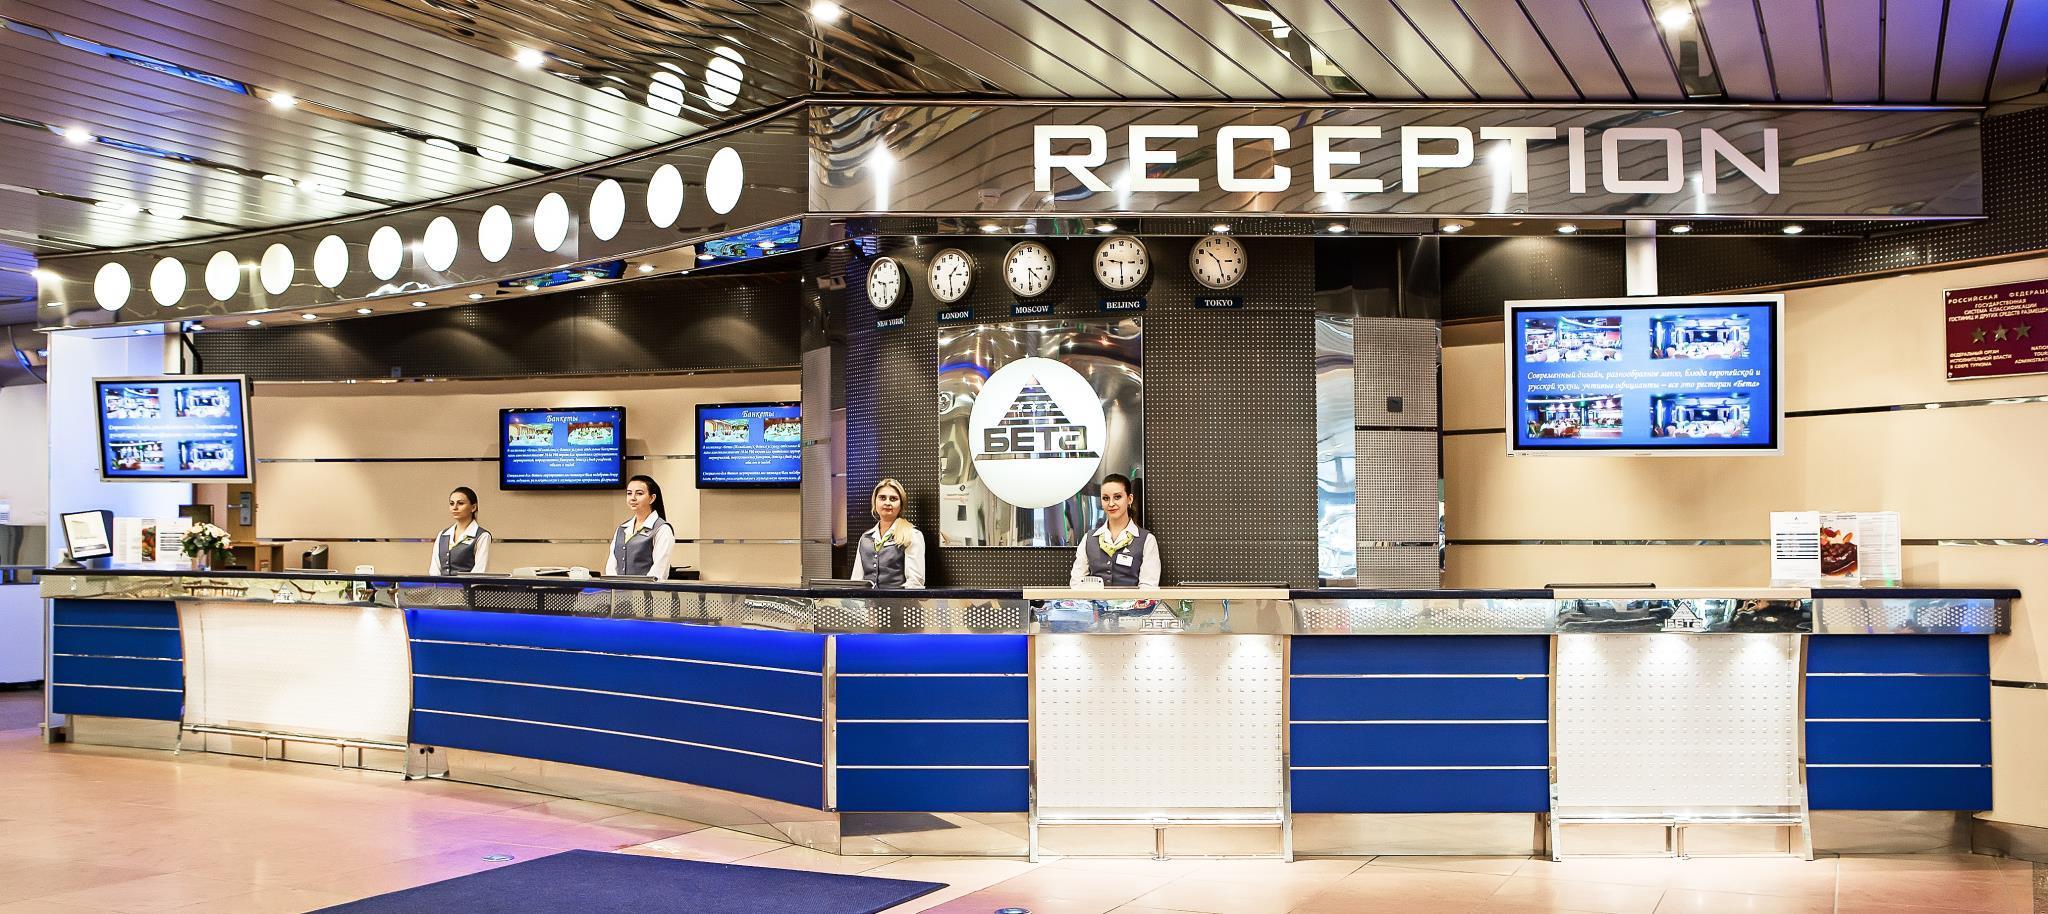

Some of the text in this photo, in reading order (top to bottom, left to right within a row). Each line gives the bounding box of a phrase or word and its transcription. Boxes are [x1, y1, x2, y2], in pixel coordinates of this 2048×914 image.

[1033, 124, 1780, 195] RECEPTION
[1204, 299, 1233, 307] TOKYO
[1948, 294, 1999, 304] РОССИЙСКАЯ
[1015, 305, 1049, 314] MOSCOW
[1106, 301, 1140, 309] BEIJING
[941, 310, 969, 320] LONDON
[877, 317, 904, 328] NEW YORK
[1527, 371, 1576, 381] Современный
[1527, 382, 1556, 392] русской
[1695, 381, 1732, 390] ресторан
[545, 414, 579, 424] Банкеты
[741, 410, 776, 419] Банкеты
